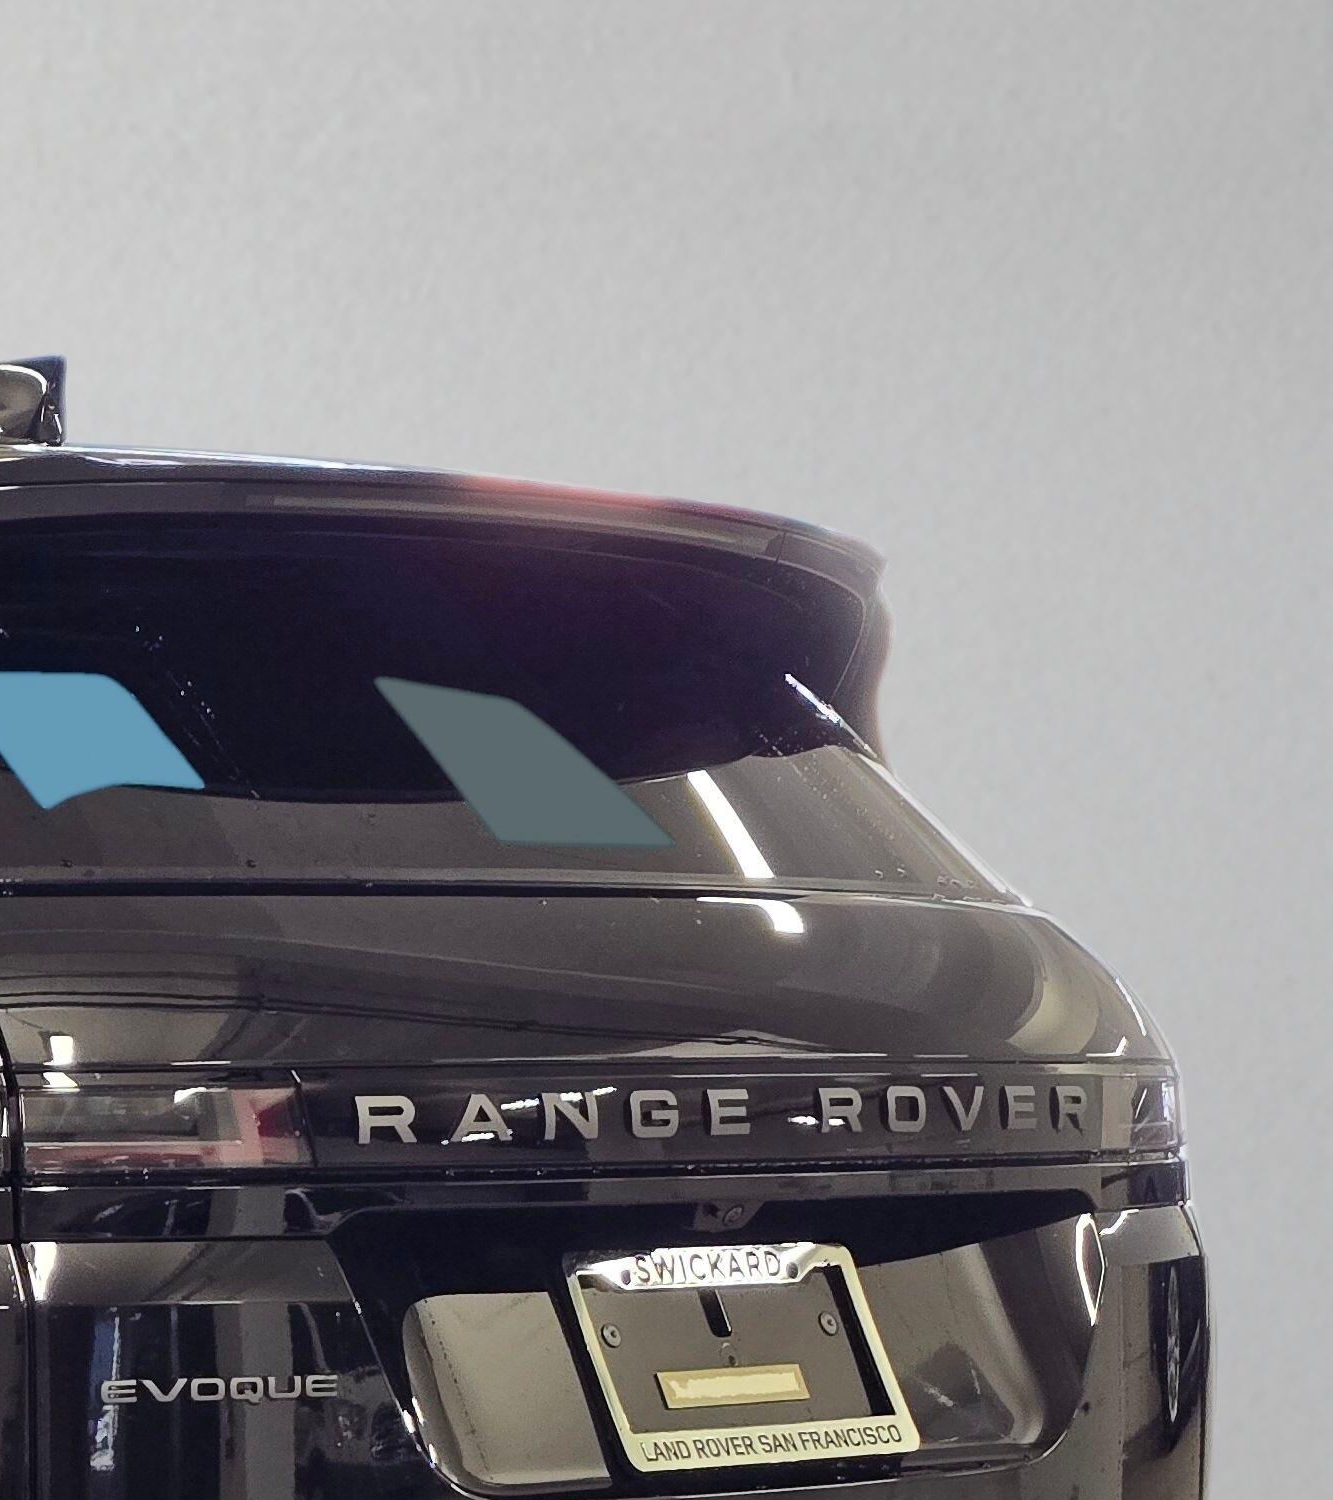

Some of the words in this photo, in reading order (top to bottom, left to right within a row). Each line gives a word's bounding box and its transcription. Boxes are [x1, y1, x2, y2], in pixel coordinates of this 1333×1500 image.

[355, 1086, 752, 1145] RANGE
[819, 1084, 1089, 1134] ROVER
[633, 1250, 782, 1285] SWICKARD
[100, 1374, 338, 1404] EVOQUE
[641, 1440, 691, 1462] LAND
[695, 1434, 756, 1459] ROVER
[760, 1431, 798, 1455] SAN
[800, 1424, 903, 1452] FRANCISCO
